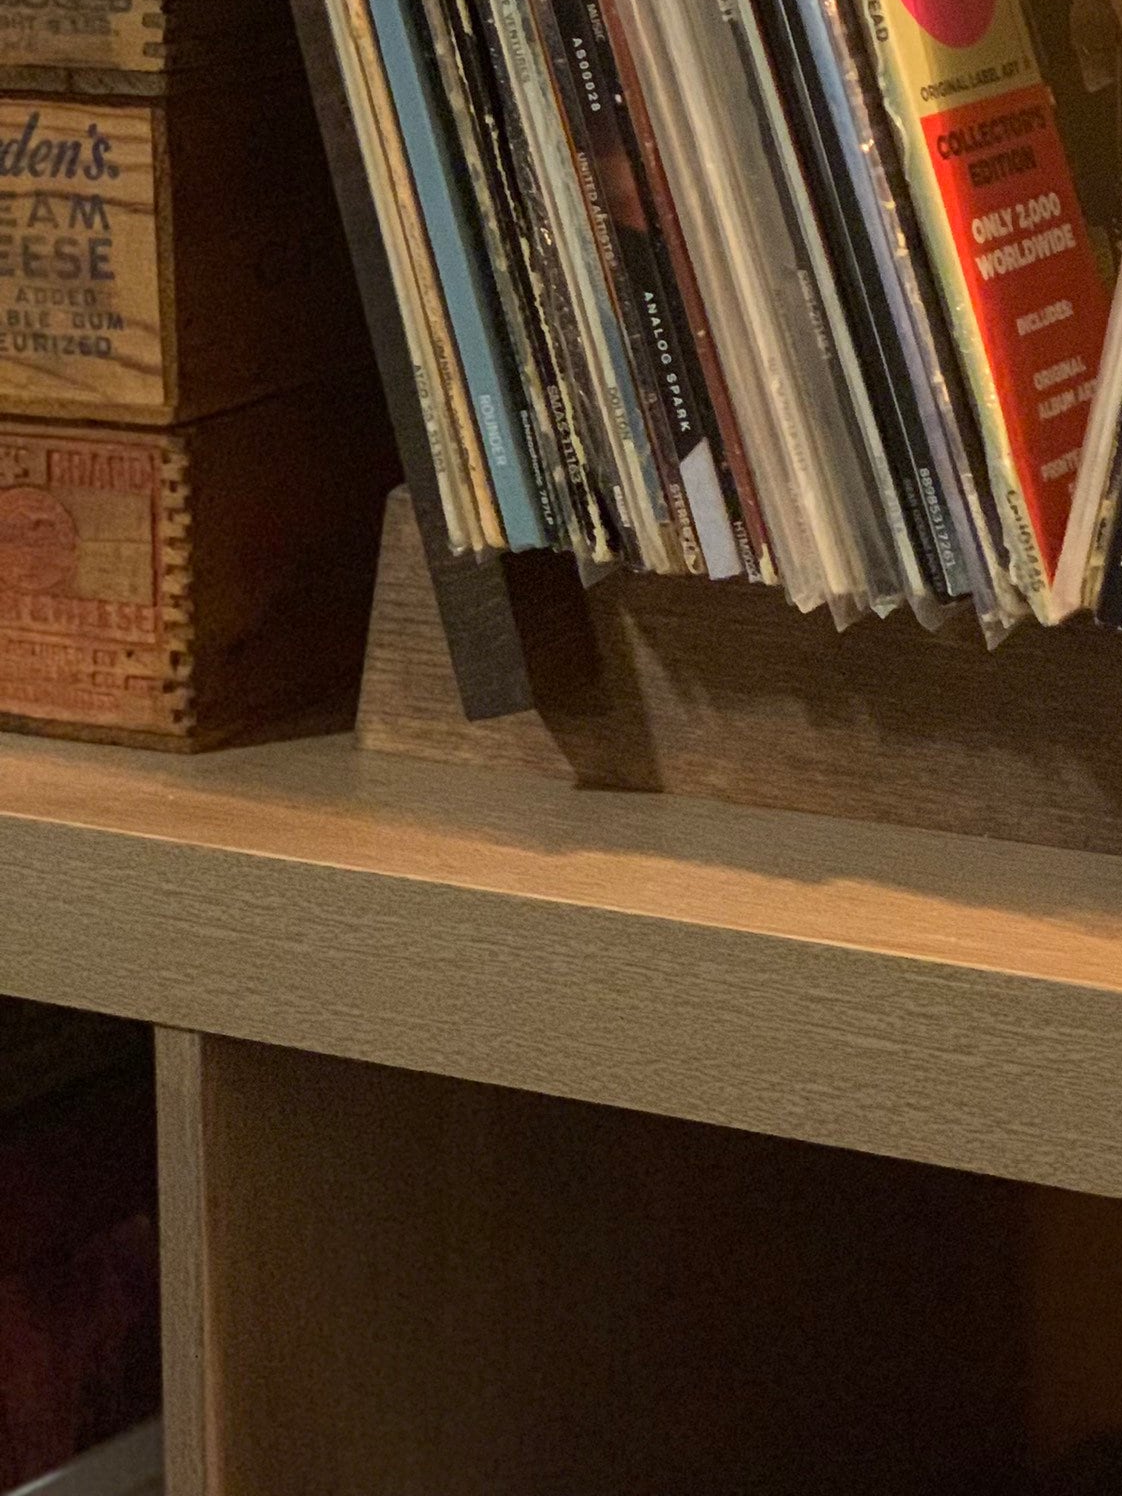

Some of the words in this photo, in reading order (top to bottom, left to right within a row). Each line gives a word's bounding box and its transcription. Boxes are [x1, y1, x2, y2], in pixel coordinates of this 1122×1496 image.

[503, 11, 531, 84] VENTURES
[585, 2, 605, 43] MUSIC
[576, 151, 598, 203] UNITED
[591, 205, 615, 260] ARTISTS
[972, 207, 1014, 244] ONLY
[1016, 193, 1061, 230] 2,000
[975, 223, 1077, 282] WORLDWIDE
[71, 311, 124, 331] GUM
[642, 290, 672, 365] ANALOG
[665, 372, 691, 432] SPARK
[477, 393, 506, 467] ROUNDER
